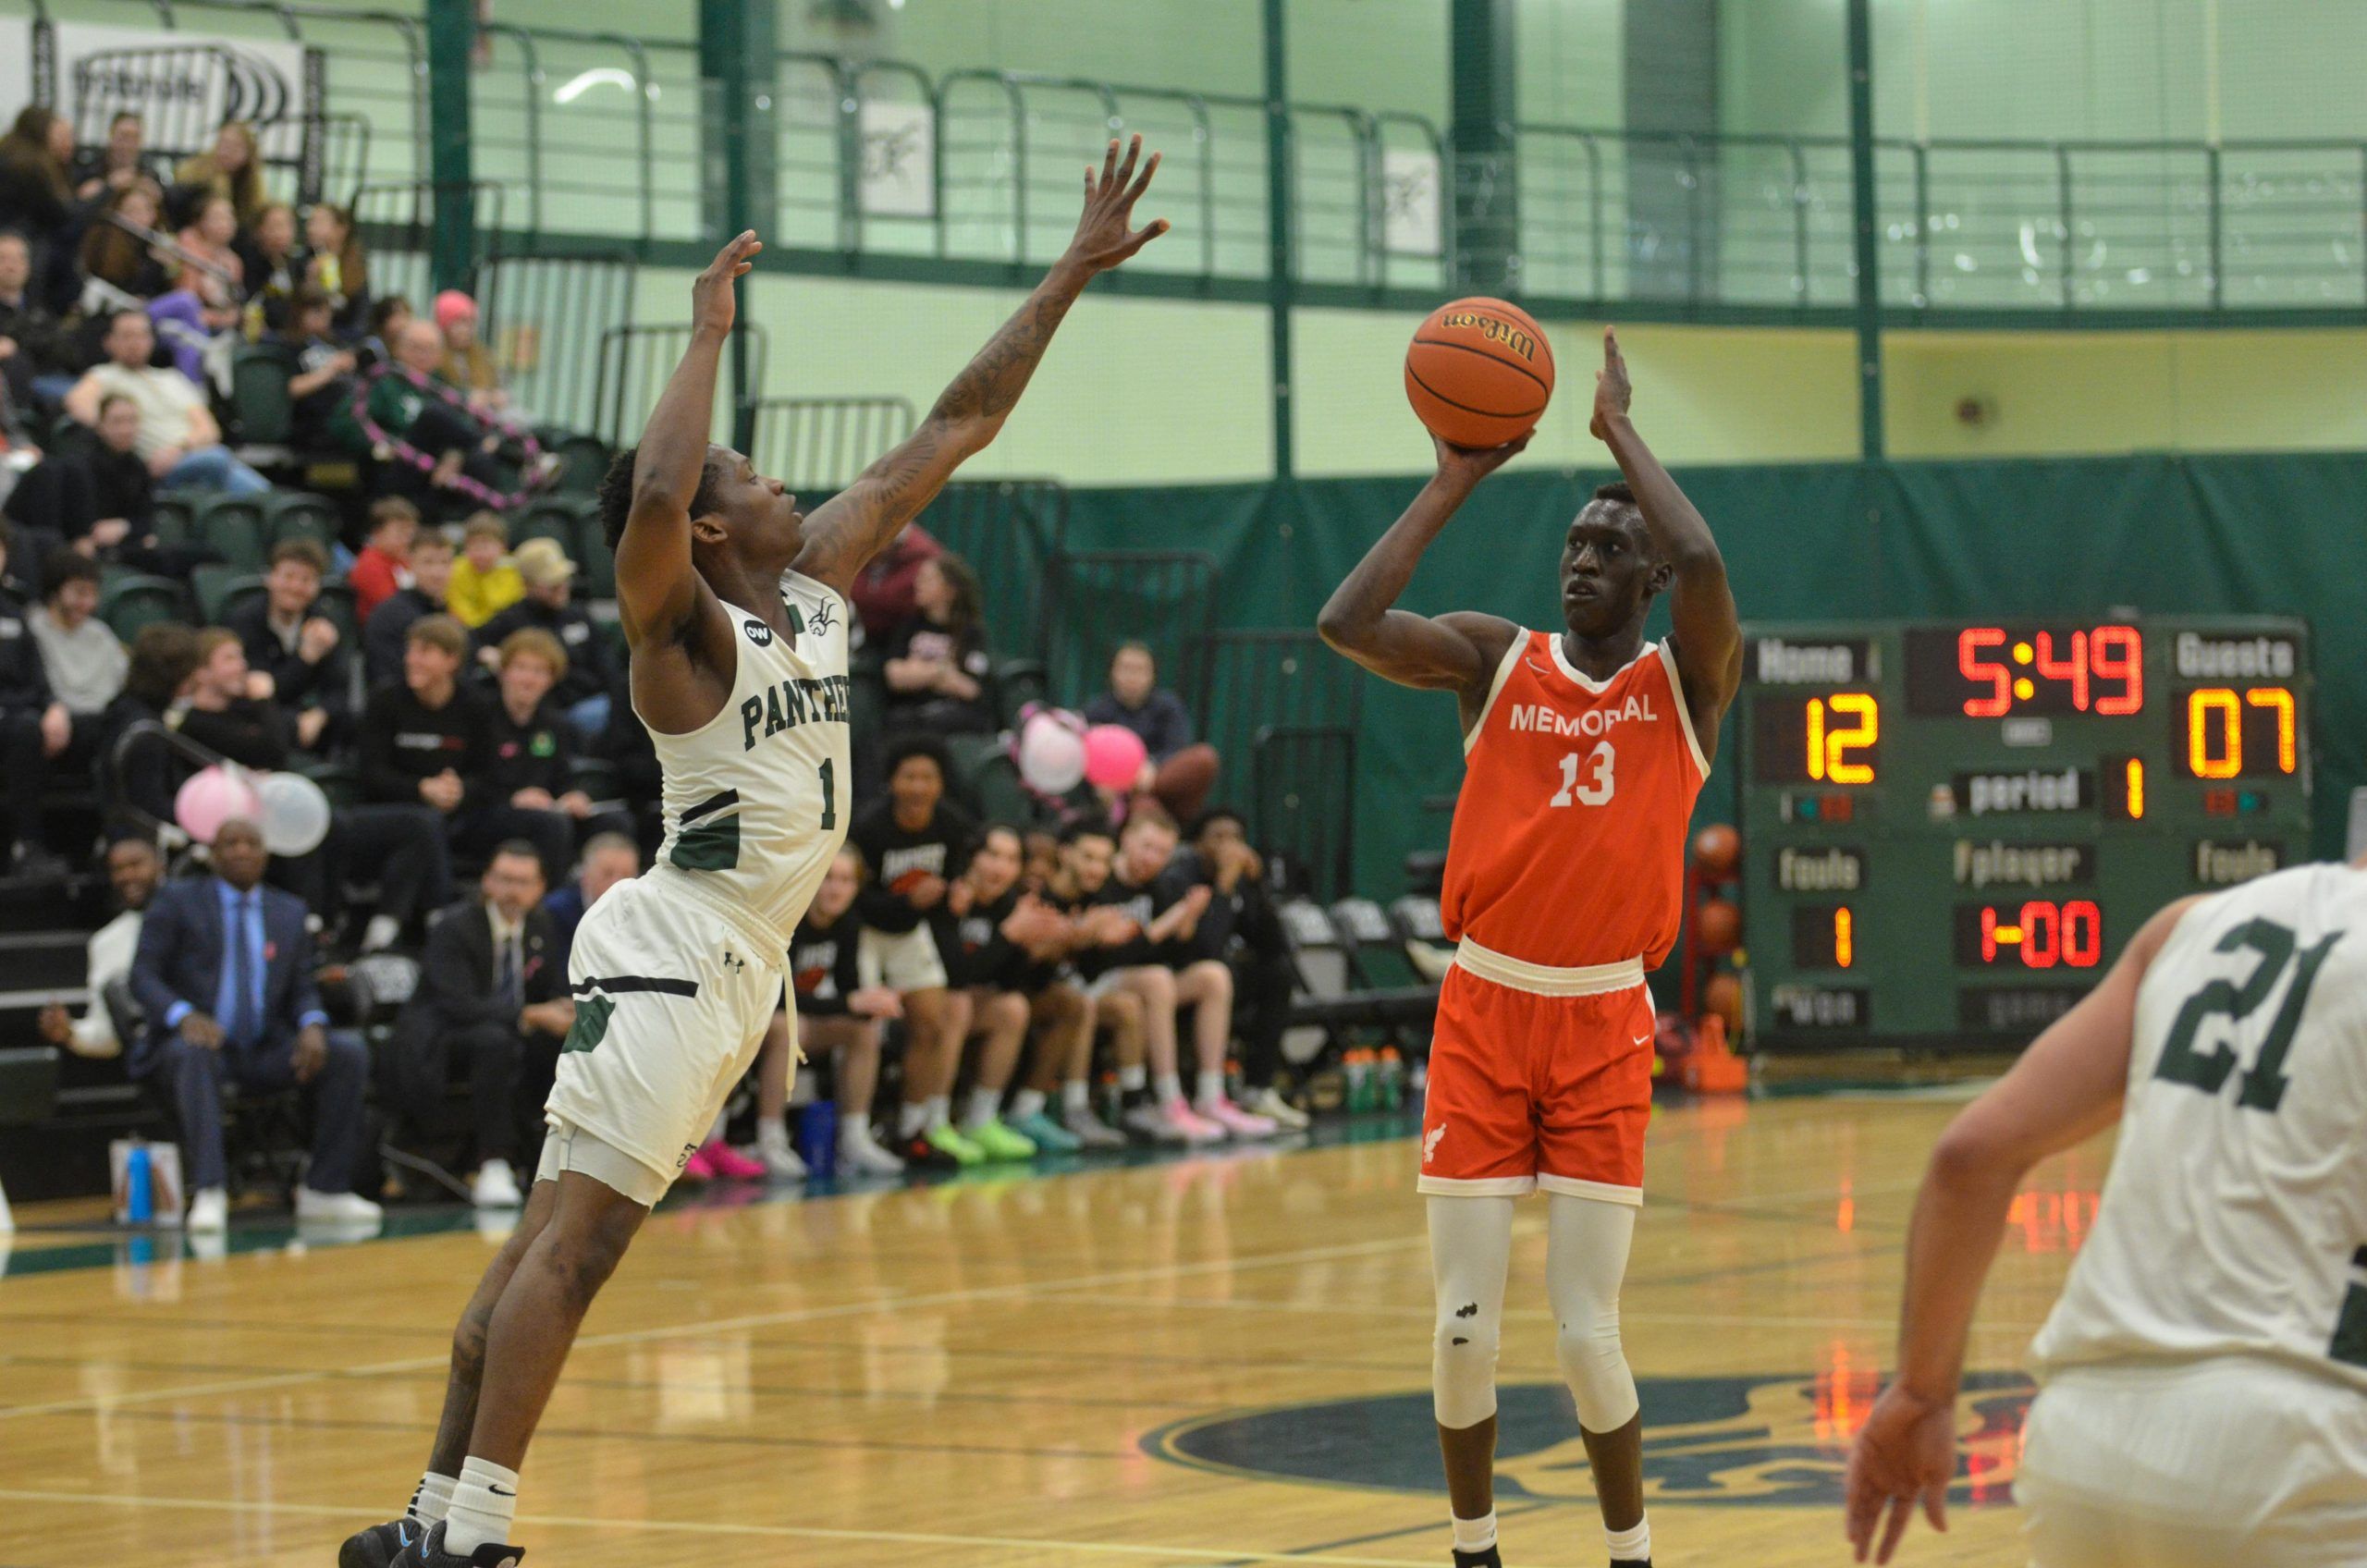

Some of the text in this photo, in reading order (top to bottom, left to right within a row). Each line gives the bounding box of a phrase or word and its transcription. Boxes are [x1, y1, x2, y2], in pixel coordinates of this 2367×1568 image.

[1440, 312, 1536, 363] Wilson
[746, 626, 767, 640] OW
[1758, 637, 1853, 684] Home
[2177, 631, 2295, 678] Guests
[1958, 626, 2143, 717] 5:49
[741, 674, 850, 752] PANTHE
[1807, 693, 1878, 784] 12
[2188, 687, 2296, 778] 07
[818, 758, 836, 830] 1
[1550, 741, 1615, 807] 13
[1969, 766, 2079, 815] period
[2127, 758, 2143, 818] 1
[1835, 907, 1852, 968] 1
[2153, 915, 2347, 1113] 21
